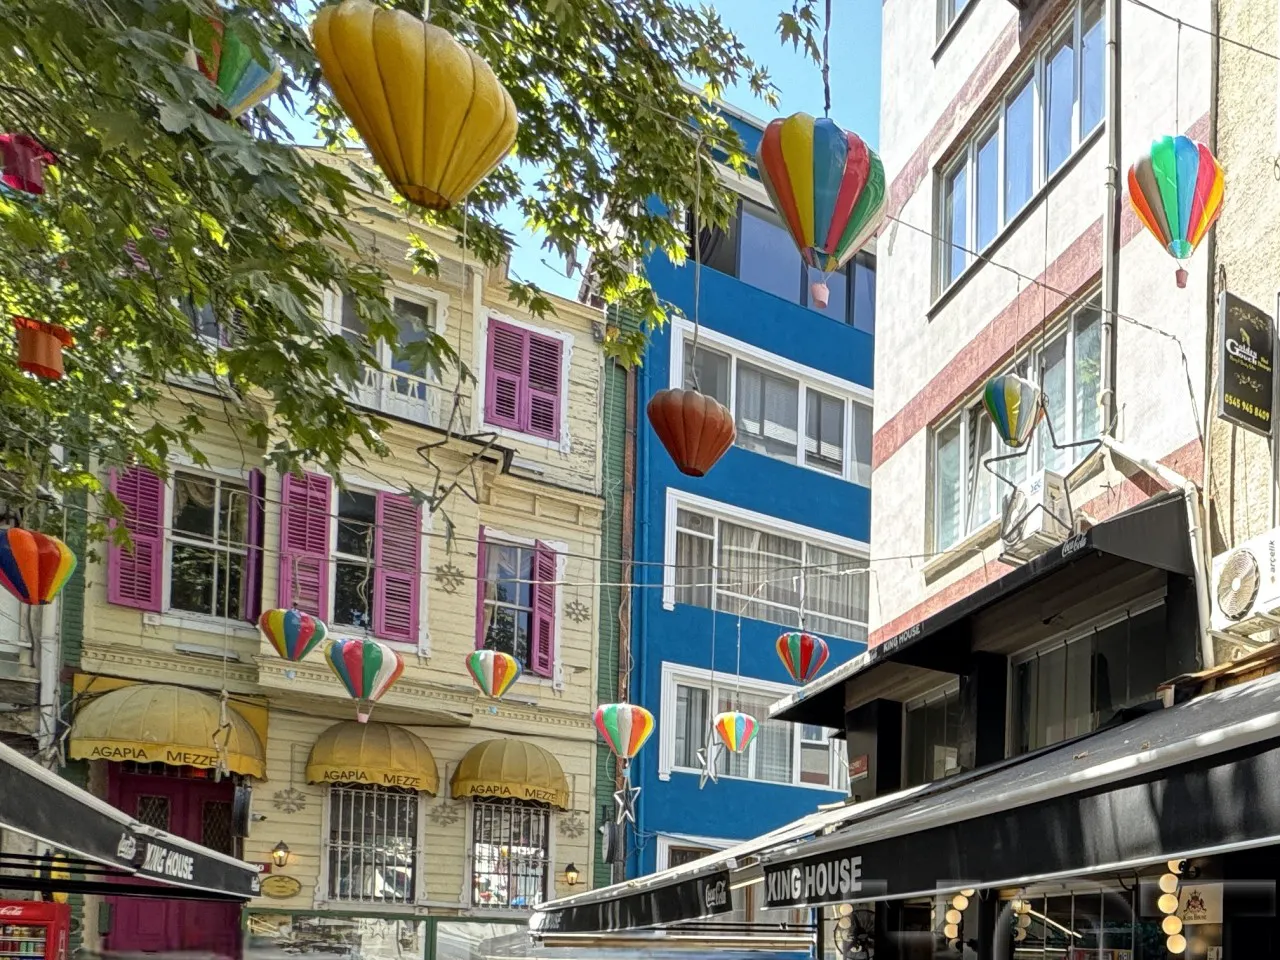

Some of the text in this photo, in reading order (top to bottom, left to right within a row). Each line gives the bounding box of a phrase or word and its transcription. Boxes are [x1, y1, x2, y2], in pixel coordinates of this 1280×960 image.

[1224, 393, 1241, 409] 0545
[1241, 400, 1254, 414] 945
[166, 750, 219, 767] MEZZE
[165, 850, 194, 880] HOUSE
[804, 855, 862, 898] HOUSE
